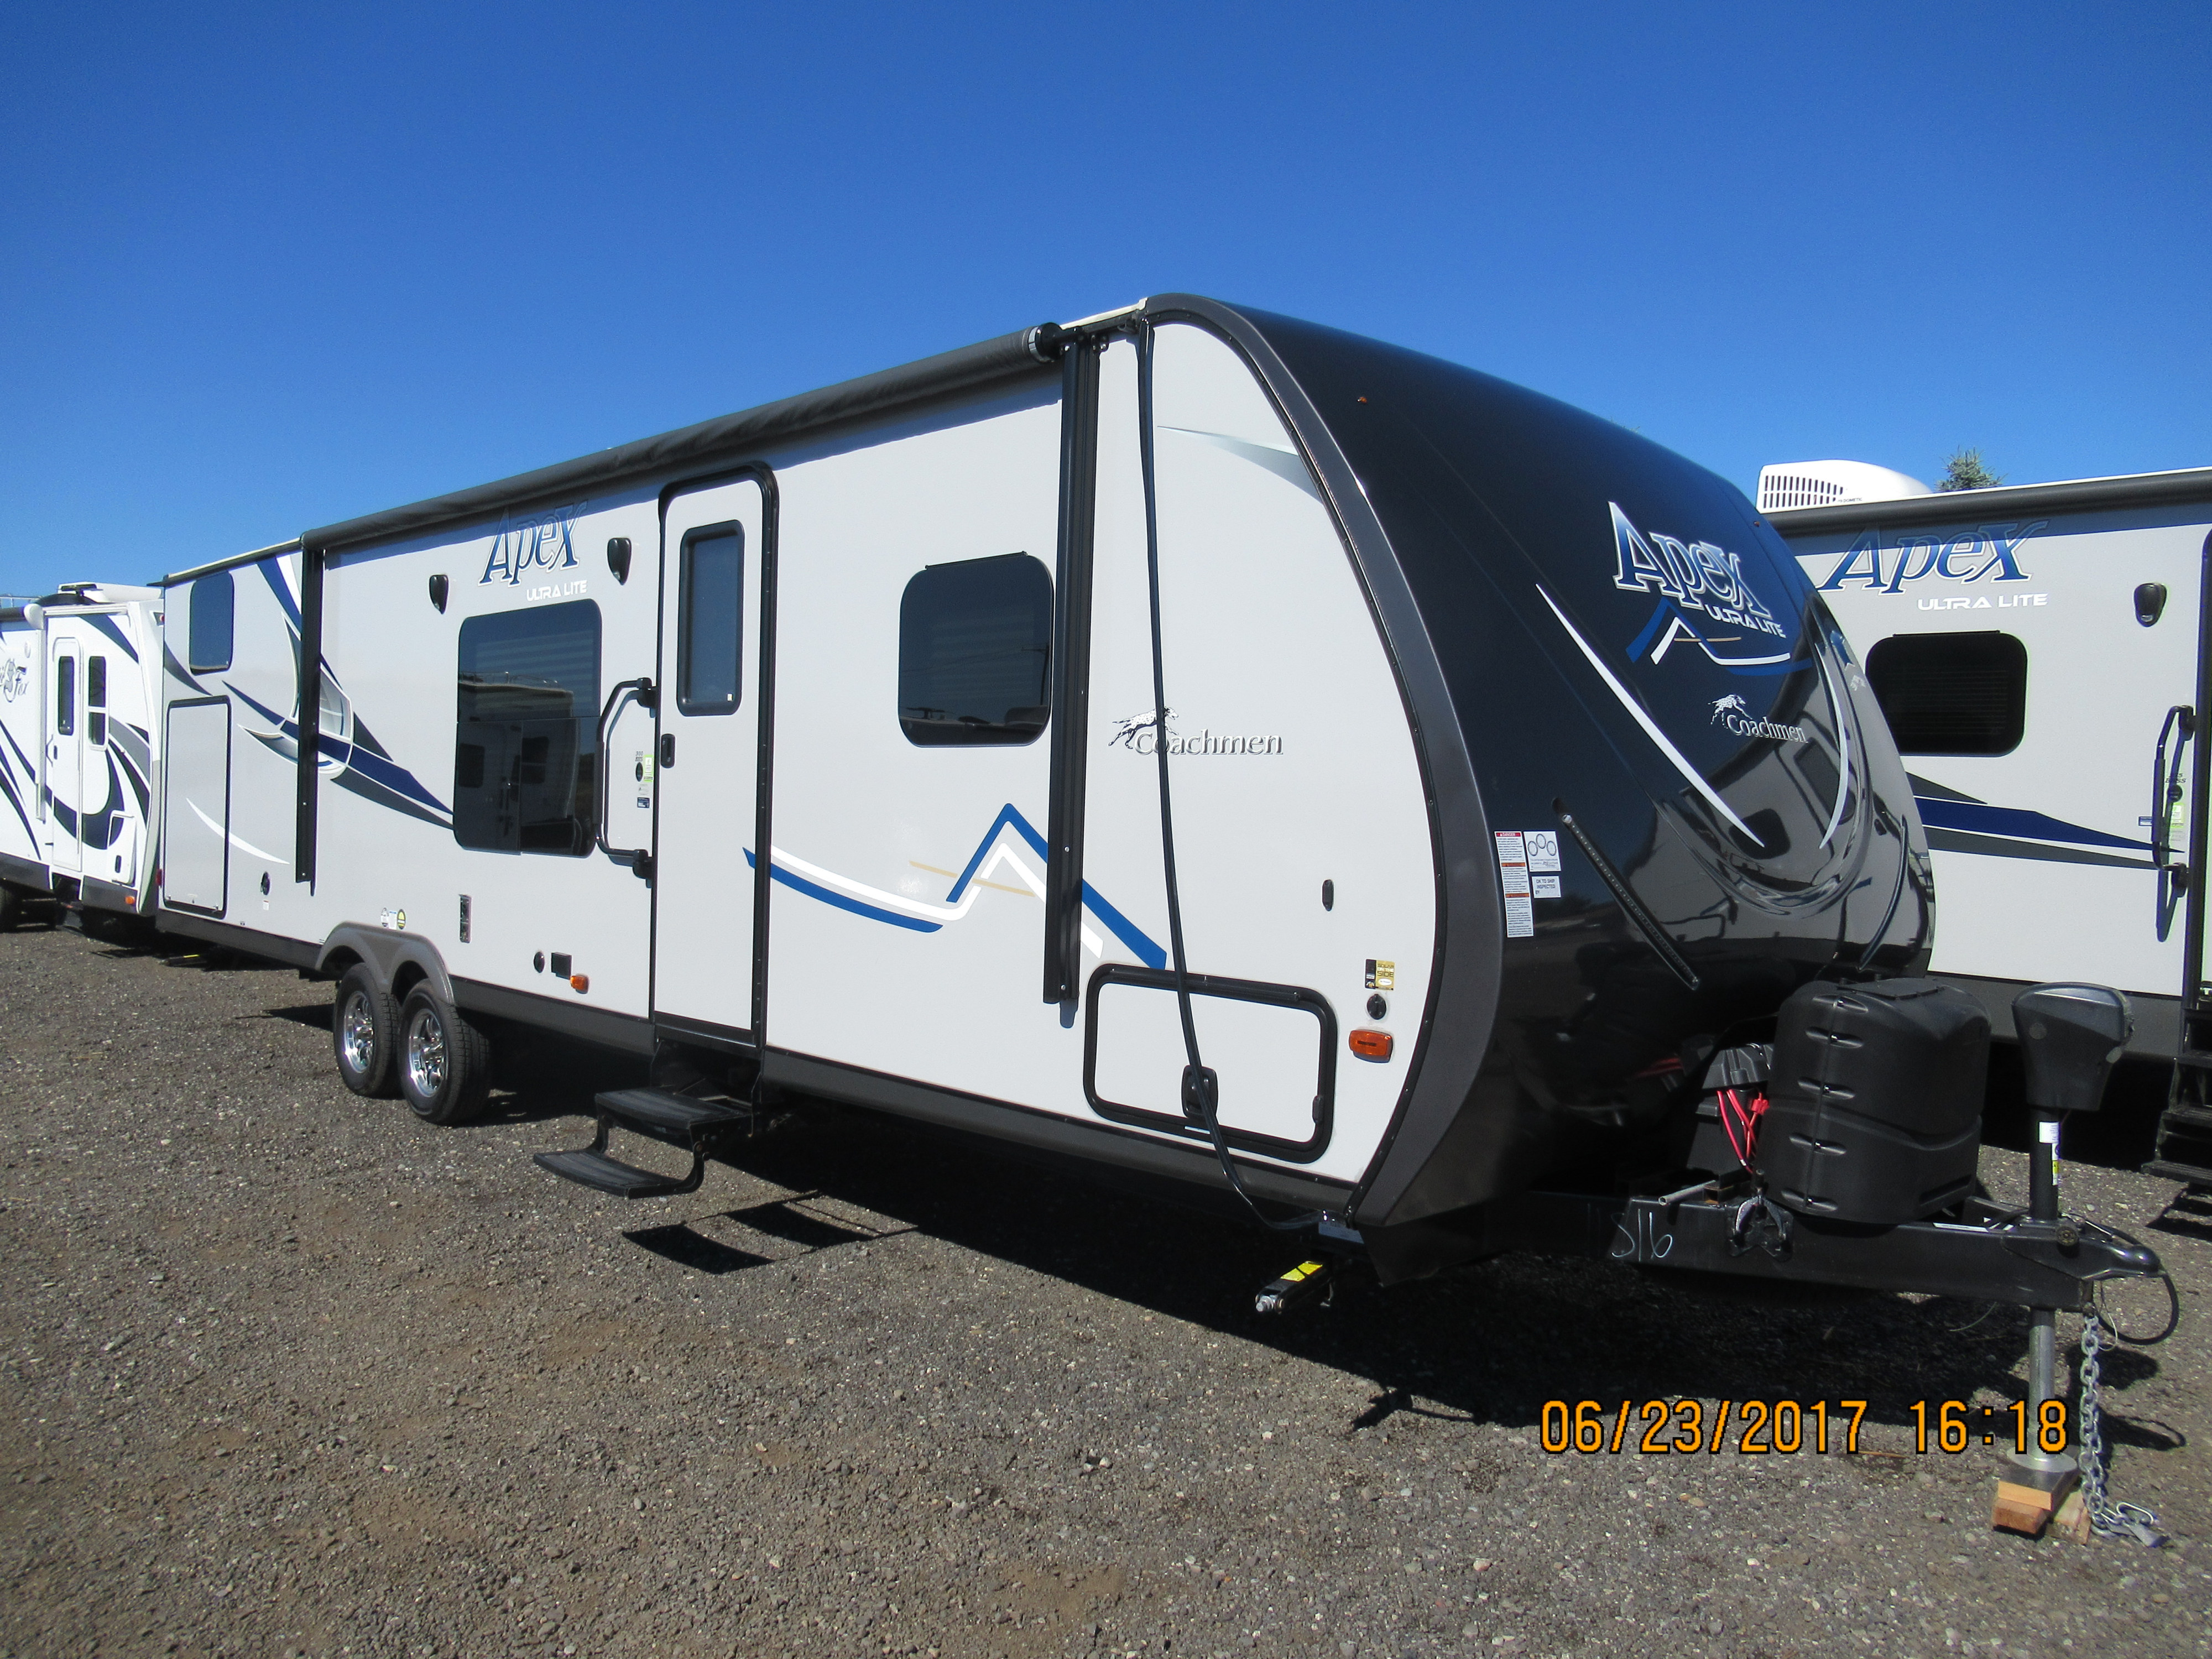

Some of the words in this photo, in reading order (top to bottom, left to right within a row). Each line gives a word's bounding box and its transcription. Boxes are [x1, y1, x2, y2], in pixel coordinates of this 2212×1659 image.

[526, 584, 562, 602] ULTRA
[564, 580, 588, 596] LITE
[1917, 597, 1992, 611] ULTRA
[1997, 593, 2049, 609] LITE
[1704, 604, 1759, 630] ULTRA
[1757, 618, 1787, 638] LITE
[1725, 713, 1809, 744] Coachmen
